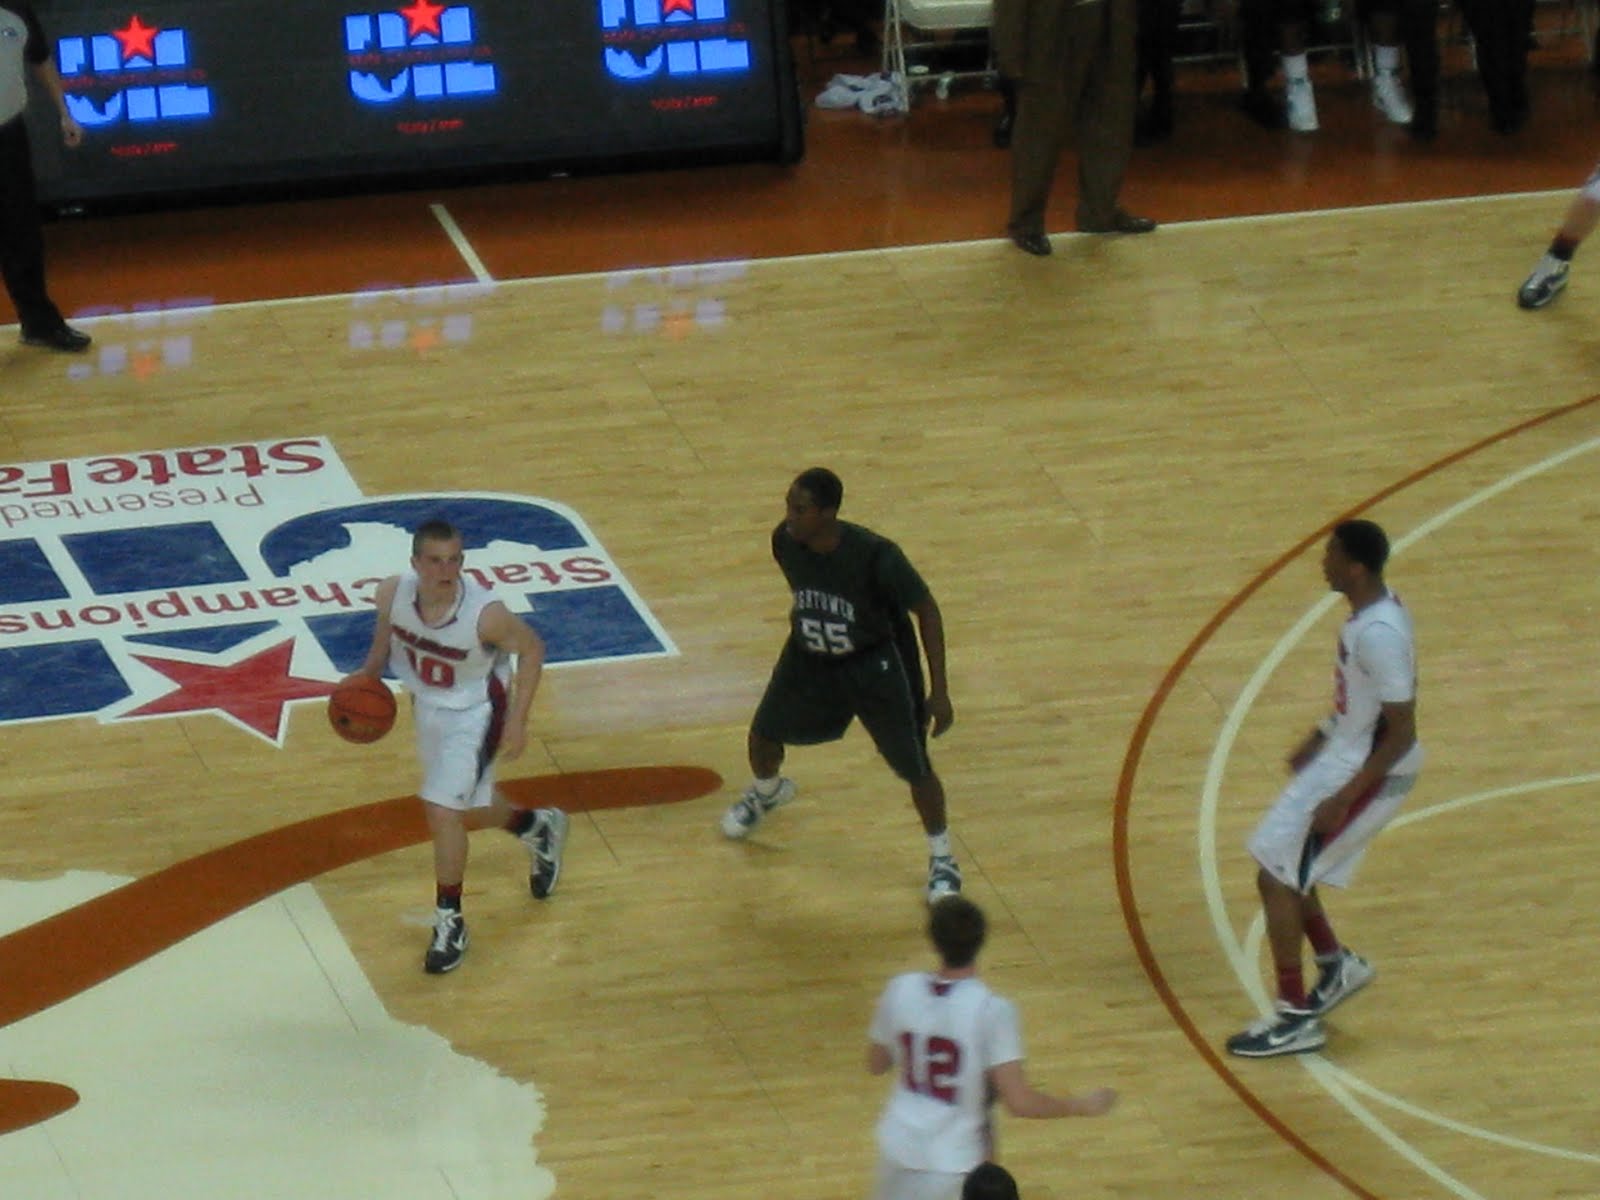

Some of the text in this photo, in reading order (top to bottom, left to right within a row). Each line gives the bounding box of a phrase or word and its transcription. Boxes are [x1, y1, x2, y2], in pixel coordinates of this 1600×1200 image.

[86, 441, 325, 485] State
[0, 484, 264, 528] Presented
[462, 556, 612, 591] Stat
[801, 618, 855, 656] 55
[403, 645, 455, 689] 10
[898, 1030, 961, 1106] 12
